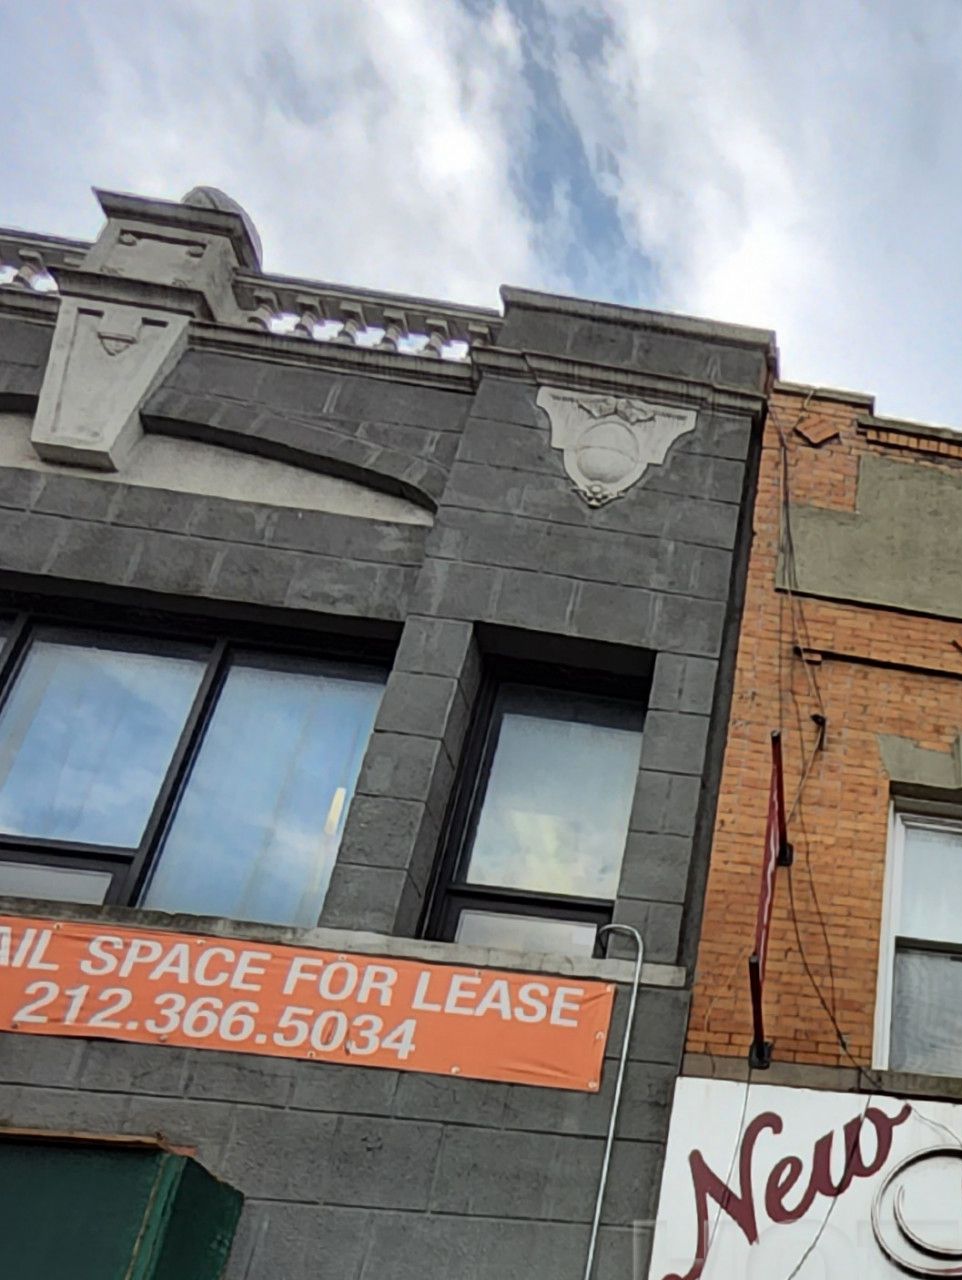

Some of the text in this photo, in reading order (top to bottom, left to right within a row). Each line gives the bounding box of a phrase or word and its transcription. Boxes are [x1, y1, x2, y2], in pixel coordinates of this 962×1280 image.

[12, 980, 418, 1061] 212.366.5034
[80, 934, 278, 992] SPACE
[283, 957, 401, 1006] FOR
[411, 971, 586, 1028] LEASE
